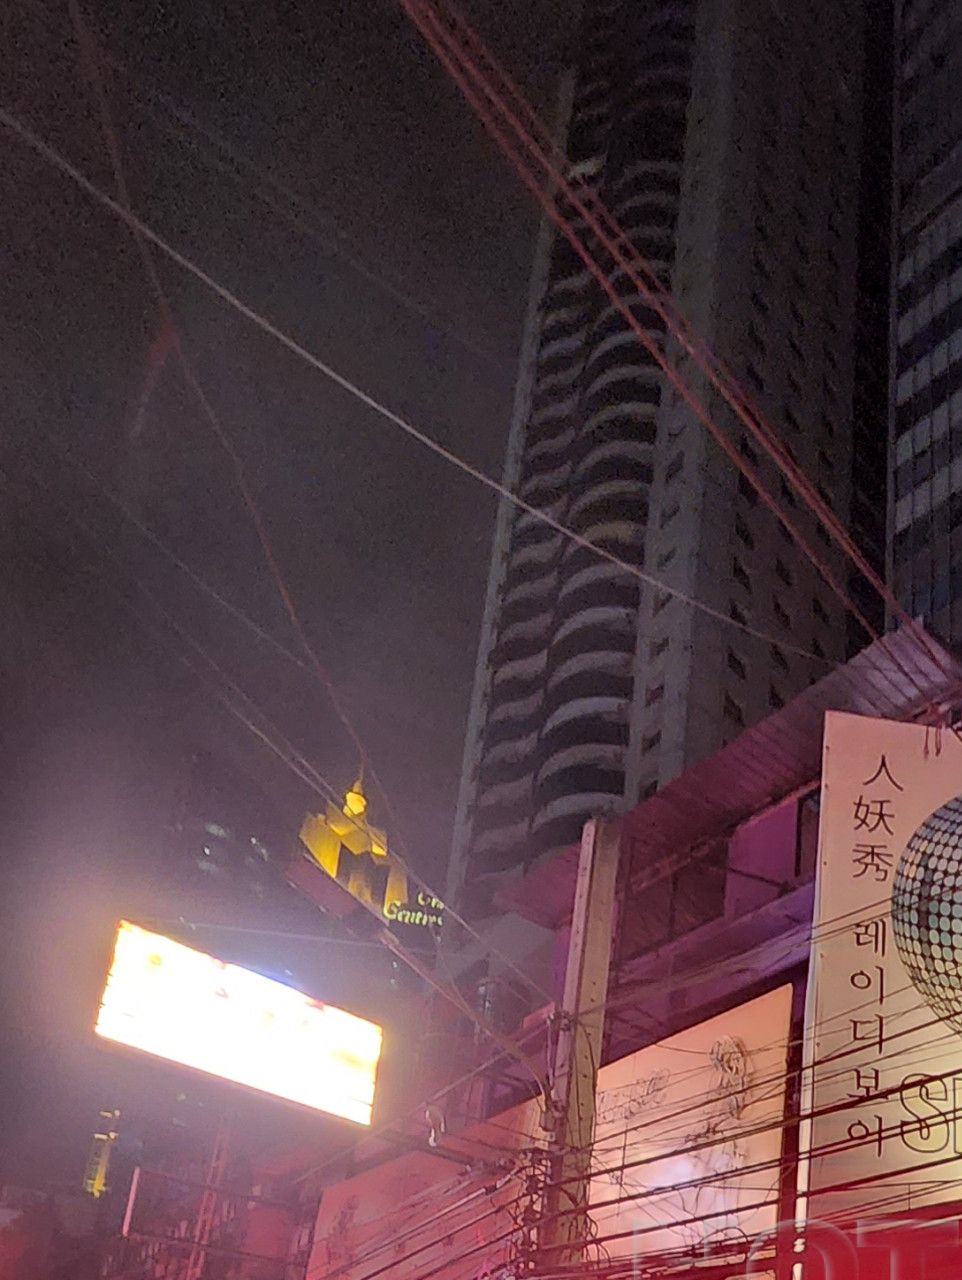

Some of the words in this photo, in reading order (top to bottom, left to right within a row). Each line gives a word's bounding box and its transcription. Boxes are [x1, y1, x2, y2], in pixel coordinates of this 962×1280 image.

[852, 753, 904, 882] 人妖秀
[847, 918, 890, 1157] 레이디보이
